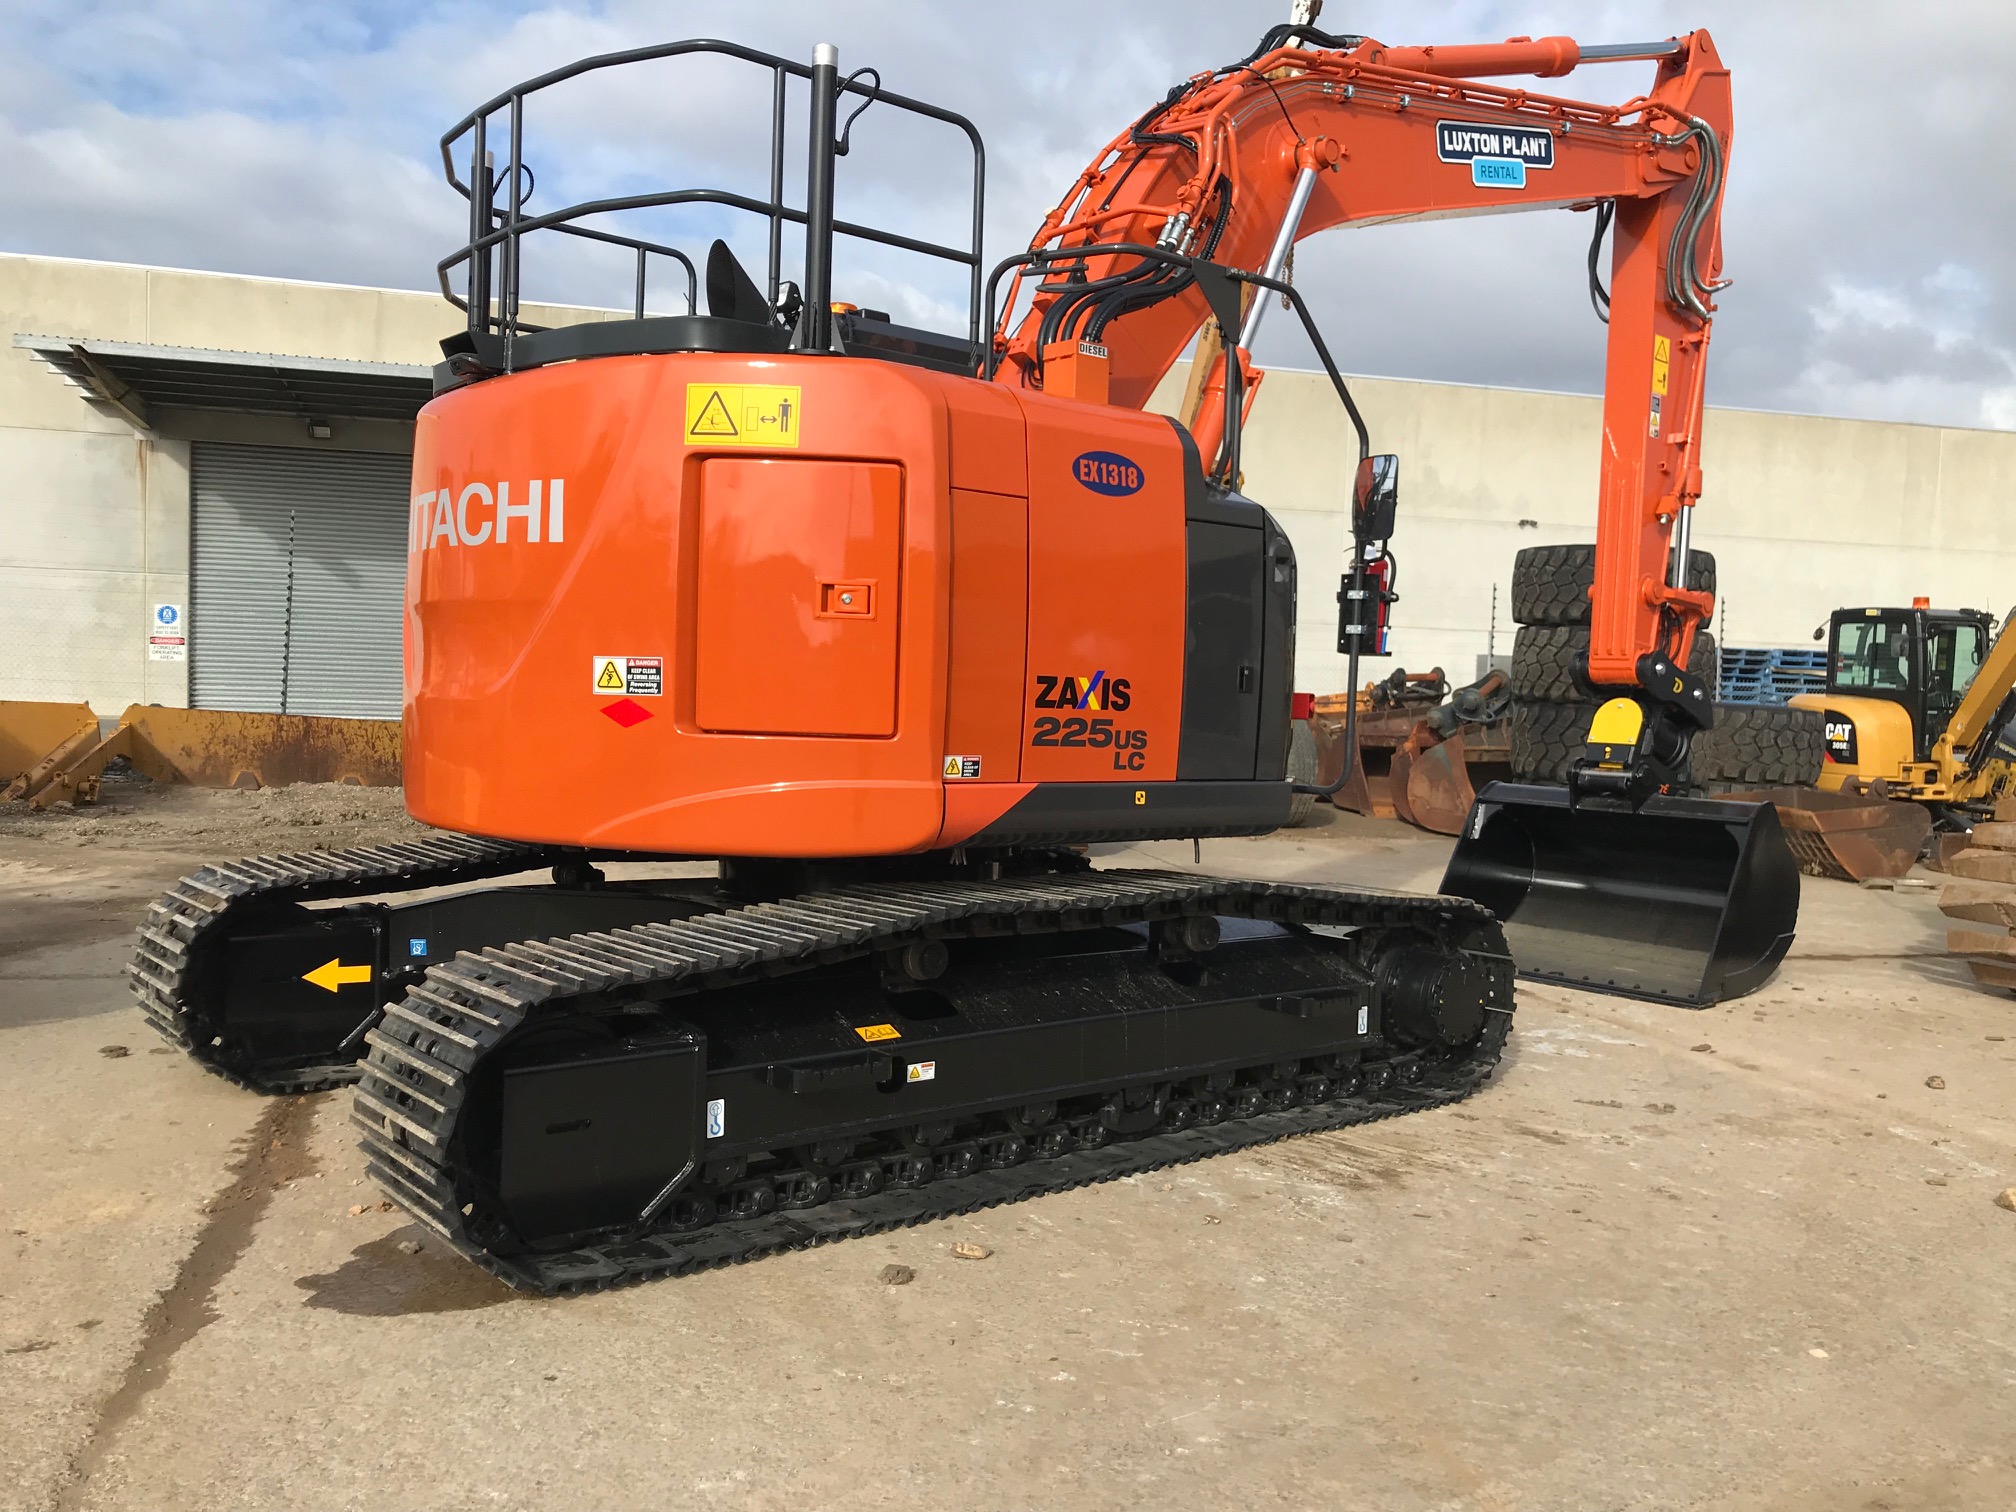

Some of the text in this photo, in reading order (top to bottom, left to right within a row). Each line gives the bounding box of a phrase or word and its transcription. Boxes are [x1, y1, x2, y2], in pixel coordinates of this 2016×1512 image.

[1443, 130, 1547, 157] LUXTON PLANT
[1480, 165, 1517, 180] RENTAL
[1079, 343, 1107, 358] DIESEL
[1079, 458, 1138, 489] EX1318
[630, 681, 657, 689] Reversing
[1034, 670, 1131, 712] ZAXIS
[1825, 722, 1852, 741] CAT
[1113, 752, 1146, 771] LC
